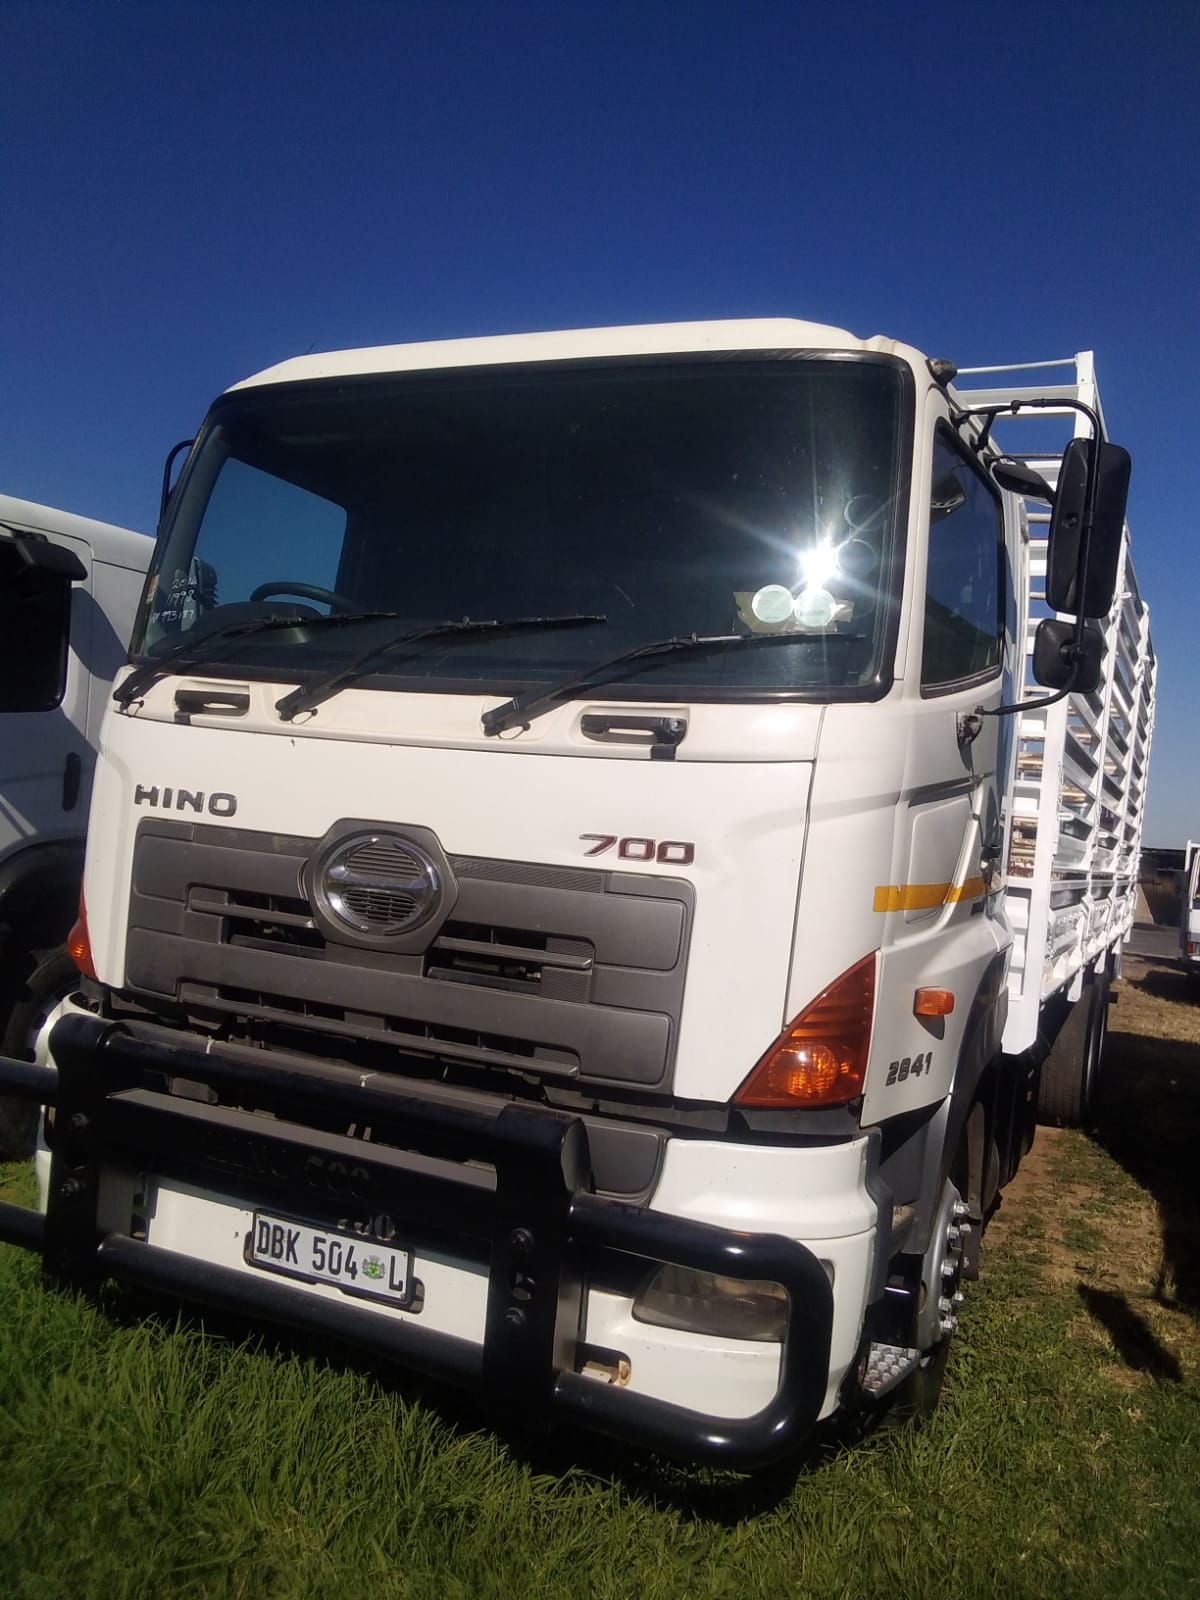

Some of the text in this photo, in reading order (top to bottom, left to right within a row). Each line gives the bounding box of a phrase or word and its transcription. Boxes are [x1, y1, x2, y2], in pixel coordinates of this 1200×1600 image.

[135, 784, 237, 817] HINO
[579, 834, 695, 866] 700
[886, 1052, 933, 1086] 2841
[257, 1220, 300, 1264] DBK
[312, 1236, 358, 1280] 504
[389, 1255, 403, 1291] L
